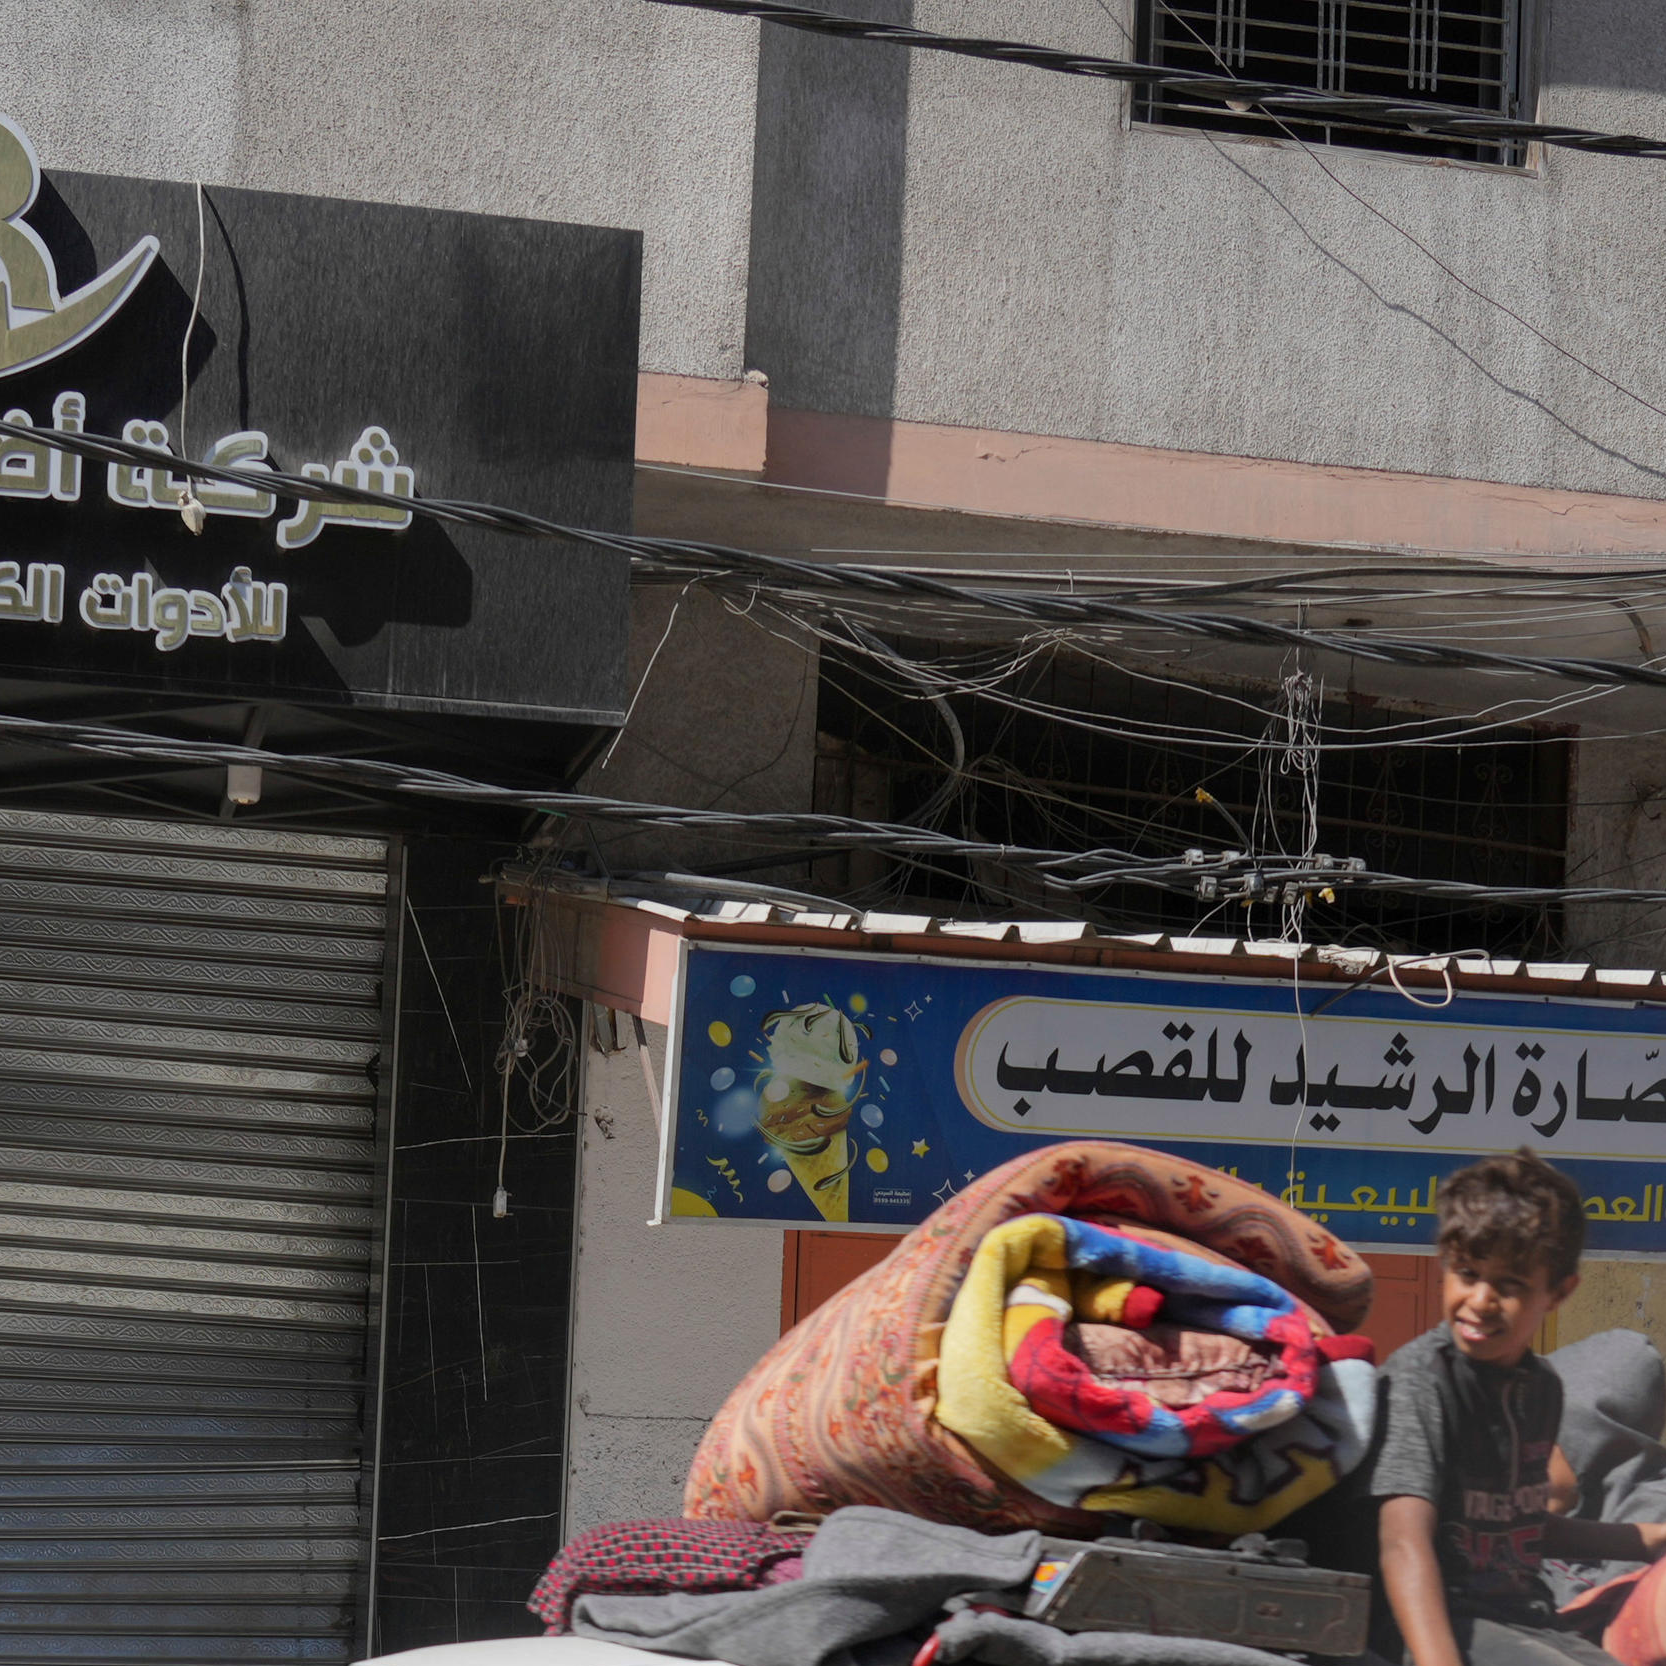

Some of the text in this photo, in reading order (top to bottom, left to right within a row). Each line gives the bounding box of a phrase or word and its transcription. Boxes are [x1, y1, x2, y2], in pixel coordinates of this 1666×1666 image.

[107, 419, 415, 549] شركة
[79, 567, 287, 651] للأدوات
[996, 1020, 1253, 1117] للقصب
[1269, 1031, 1497, 1134] الرشيد
